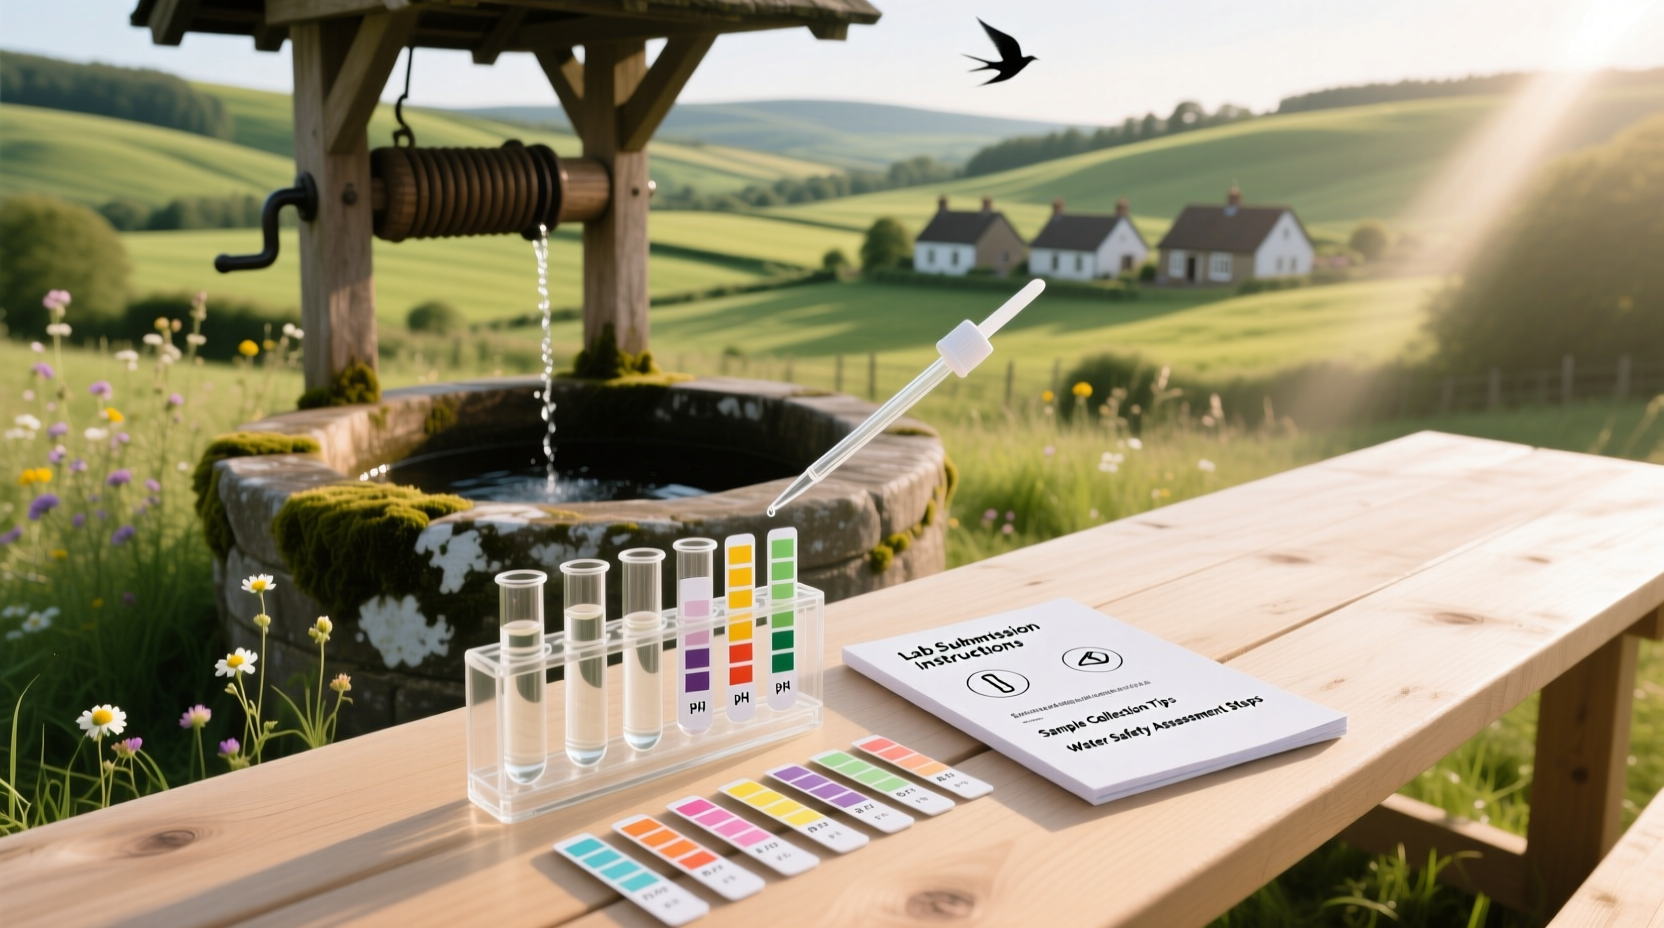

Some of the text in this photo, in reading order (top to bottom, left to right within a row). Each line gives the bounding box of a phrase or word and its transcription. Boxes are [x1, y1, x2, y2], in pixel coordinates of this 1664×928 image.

[897, 645, 934, 661] Lab
[914, 640, 1024, 671] Instructions
[775, 680, 791, 695] pH
[734, 691, 750, 706] pH
[689, 701, 706, 715] pH
[1038, 720, 1087, 738] Sample
[1145, 697, 1177, 708] Tips
[1066, 737, 1109, 752] Water
[1109, 726, 1152, 742] Safety
